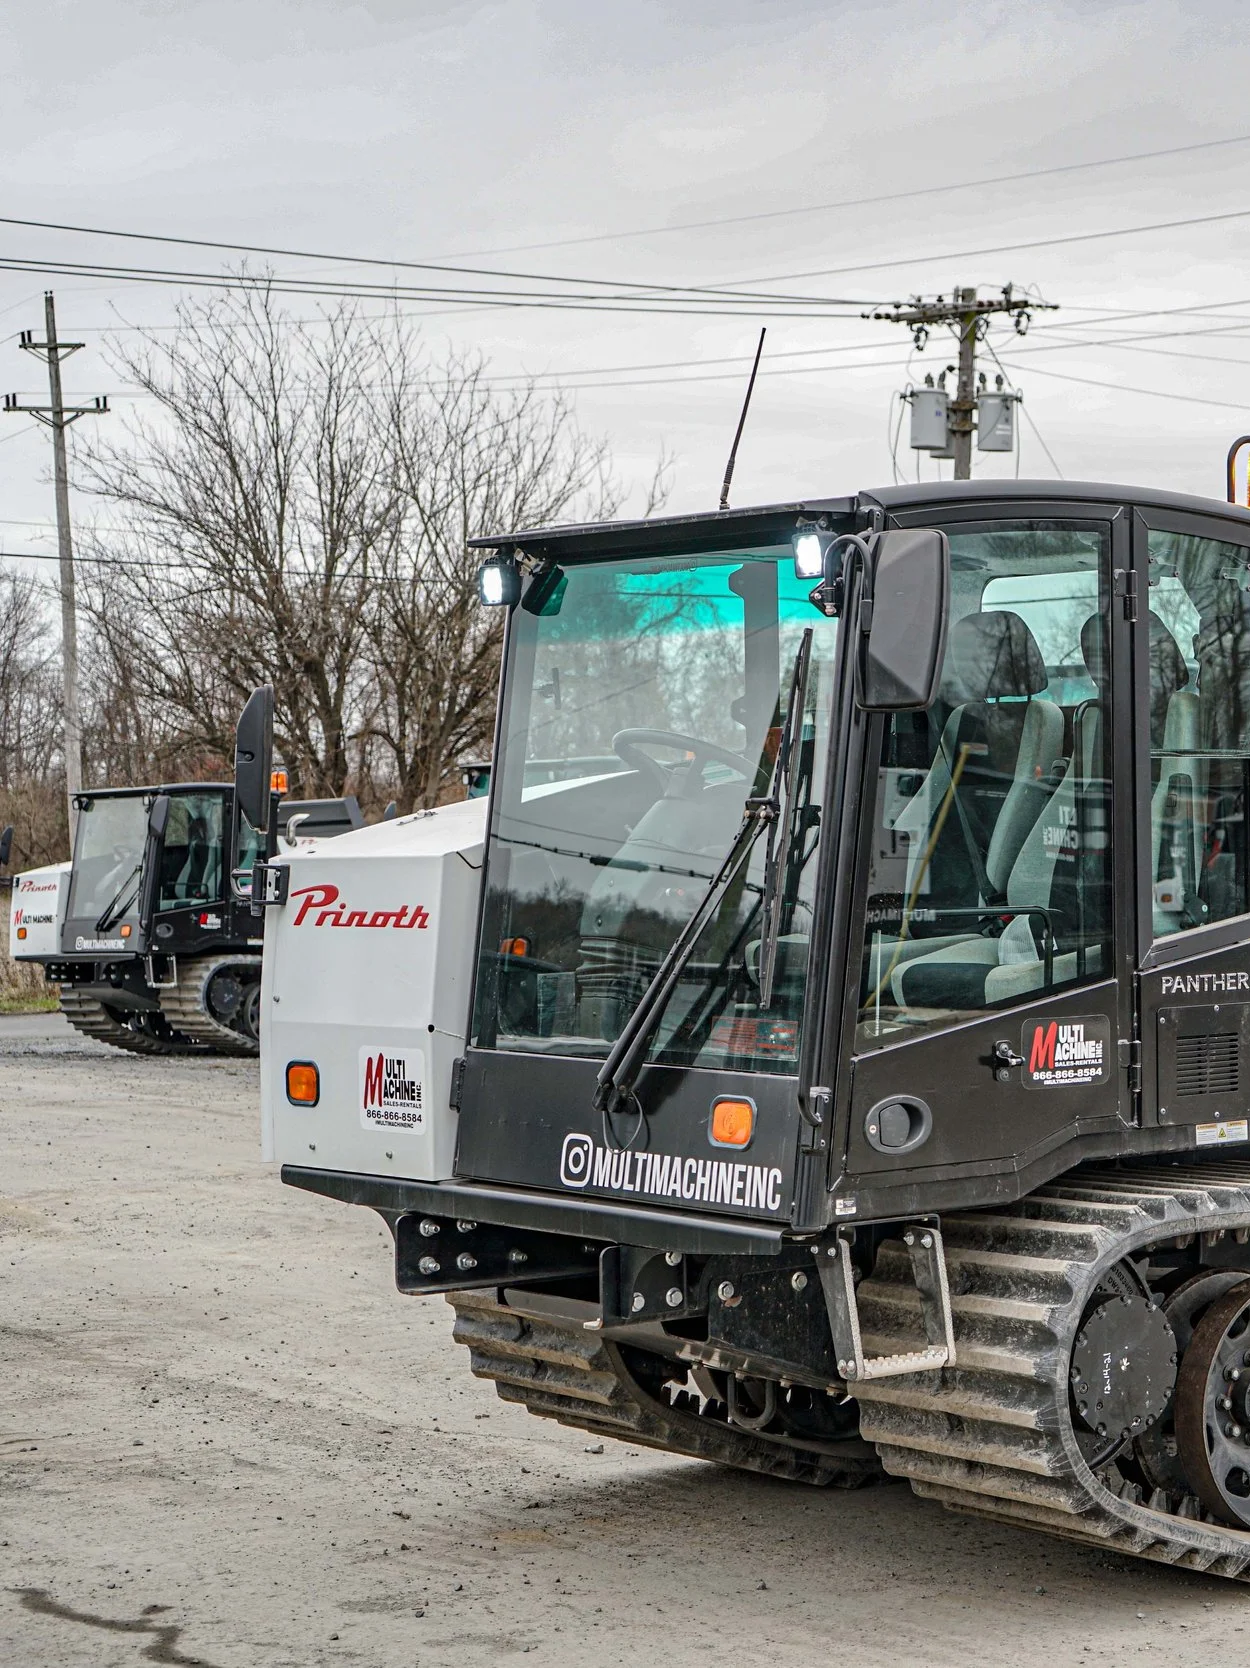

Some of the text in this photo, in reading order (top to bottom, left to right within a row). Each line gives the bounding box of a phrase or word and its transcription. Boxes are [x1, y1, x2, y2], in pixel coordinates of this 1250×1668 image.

[290, 885, 430, 929] Prinoth
[1161, 971, 1250, 995] PANTHER
[1032, 1067, 1103, 1080] 866-866-8584
[366, 1109, 422, 1123] 866-866-8584
[592, 1147, 782, 1211] MULTIMACHINEINC
